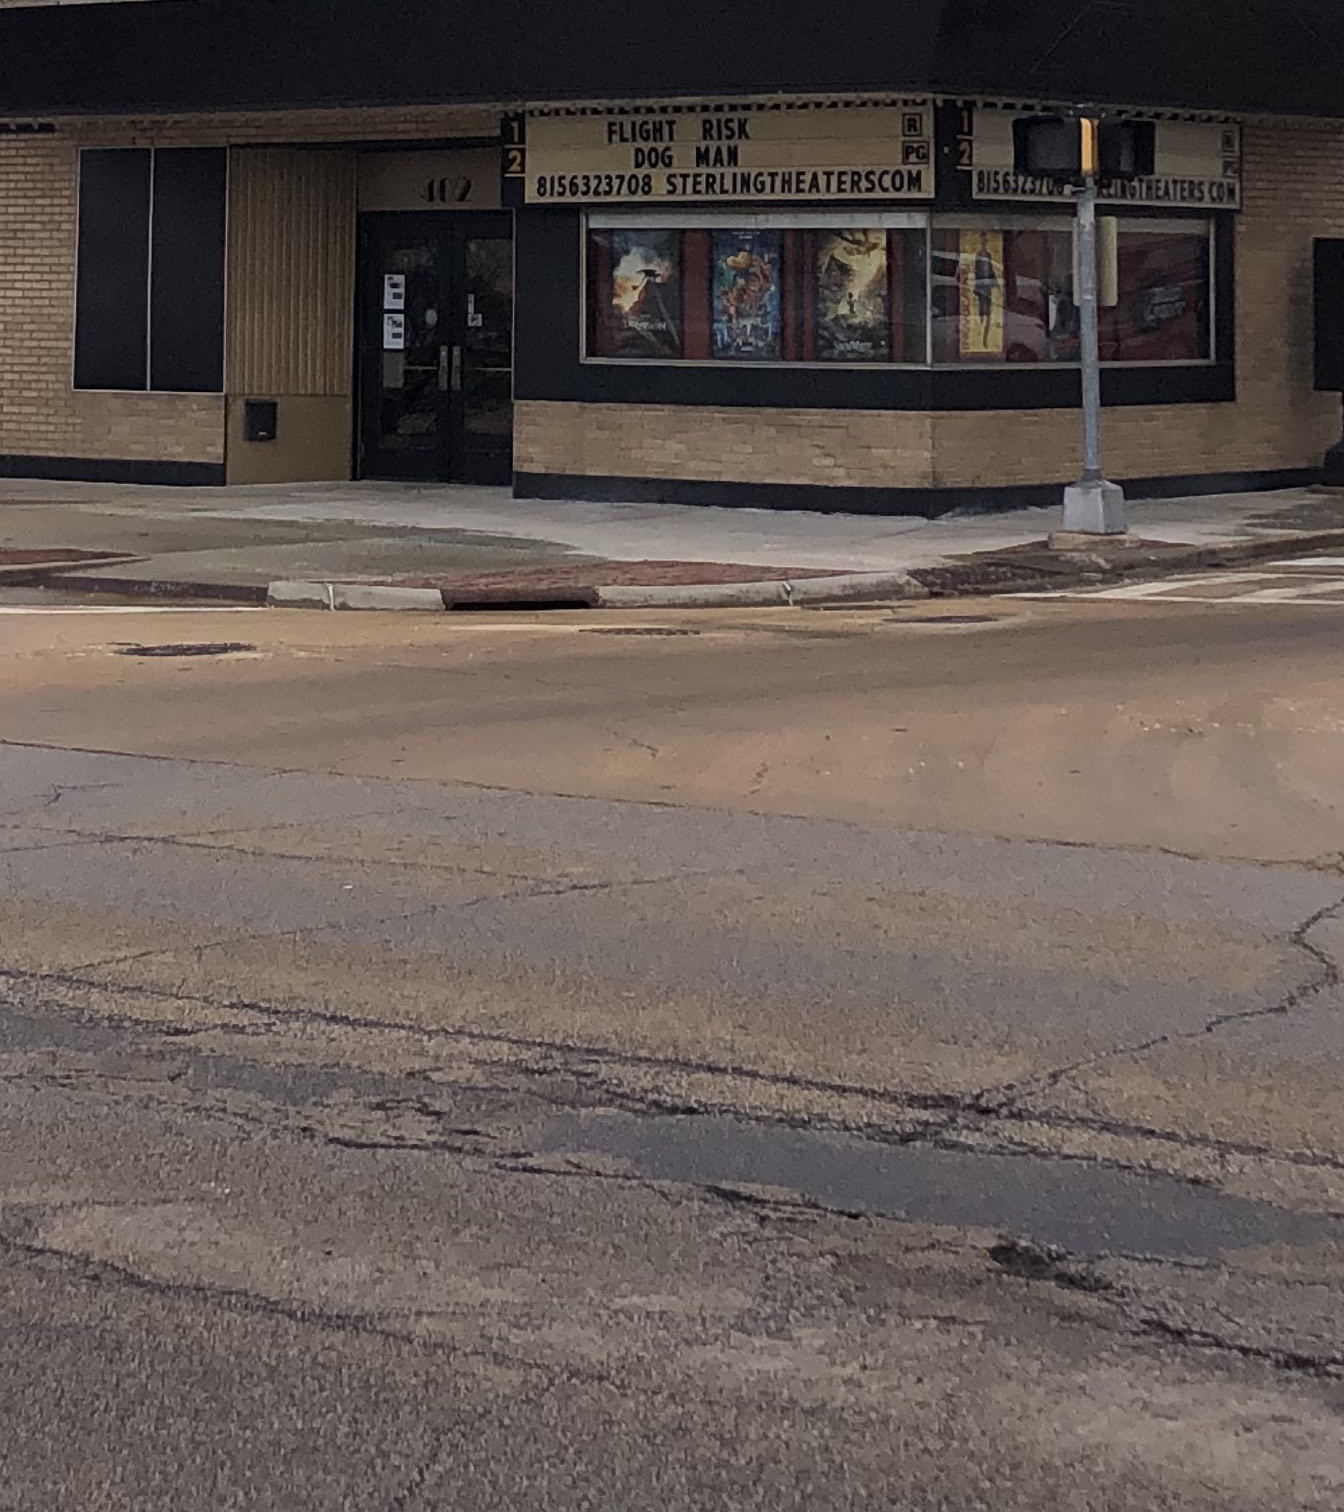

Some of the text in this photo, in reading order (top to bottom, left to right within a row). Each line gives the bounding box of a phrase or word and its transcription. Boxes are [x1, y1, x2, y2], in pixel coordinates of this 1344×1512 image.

[510, 120, 520, 144] 1
[607, 117, 749, 144] FLIGHT RISK
[906, 117, 918, 133] R
[508, 149, 522, 172] 2
[634, 144, 738, 169] DOG MAN
[905, 144, 928, 161] PG
[959, 140, 971, 165] 2
[536, 168, 922, 197] 8156323708 STERLINGTHEATERSCOM
